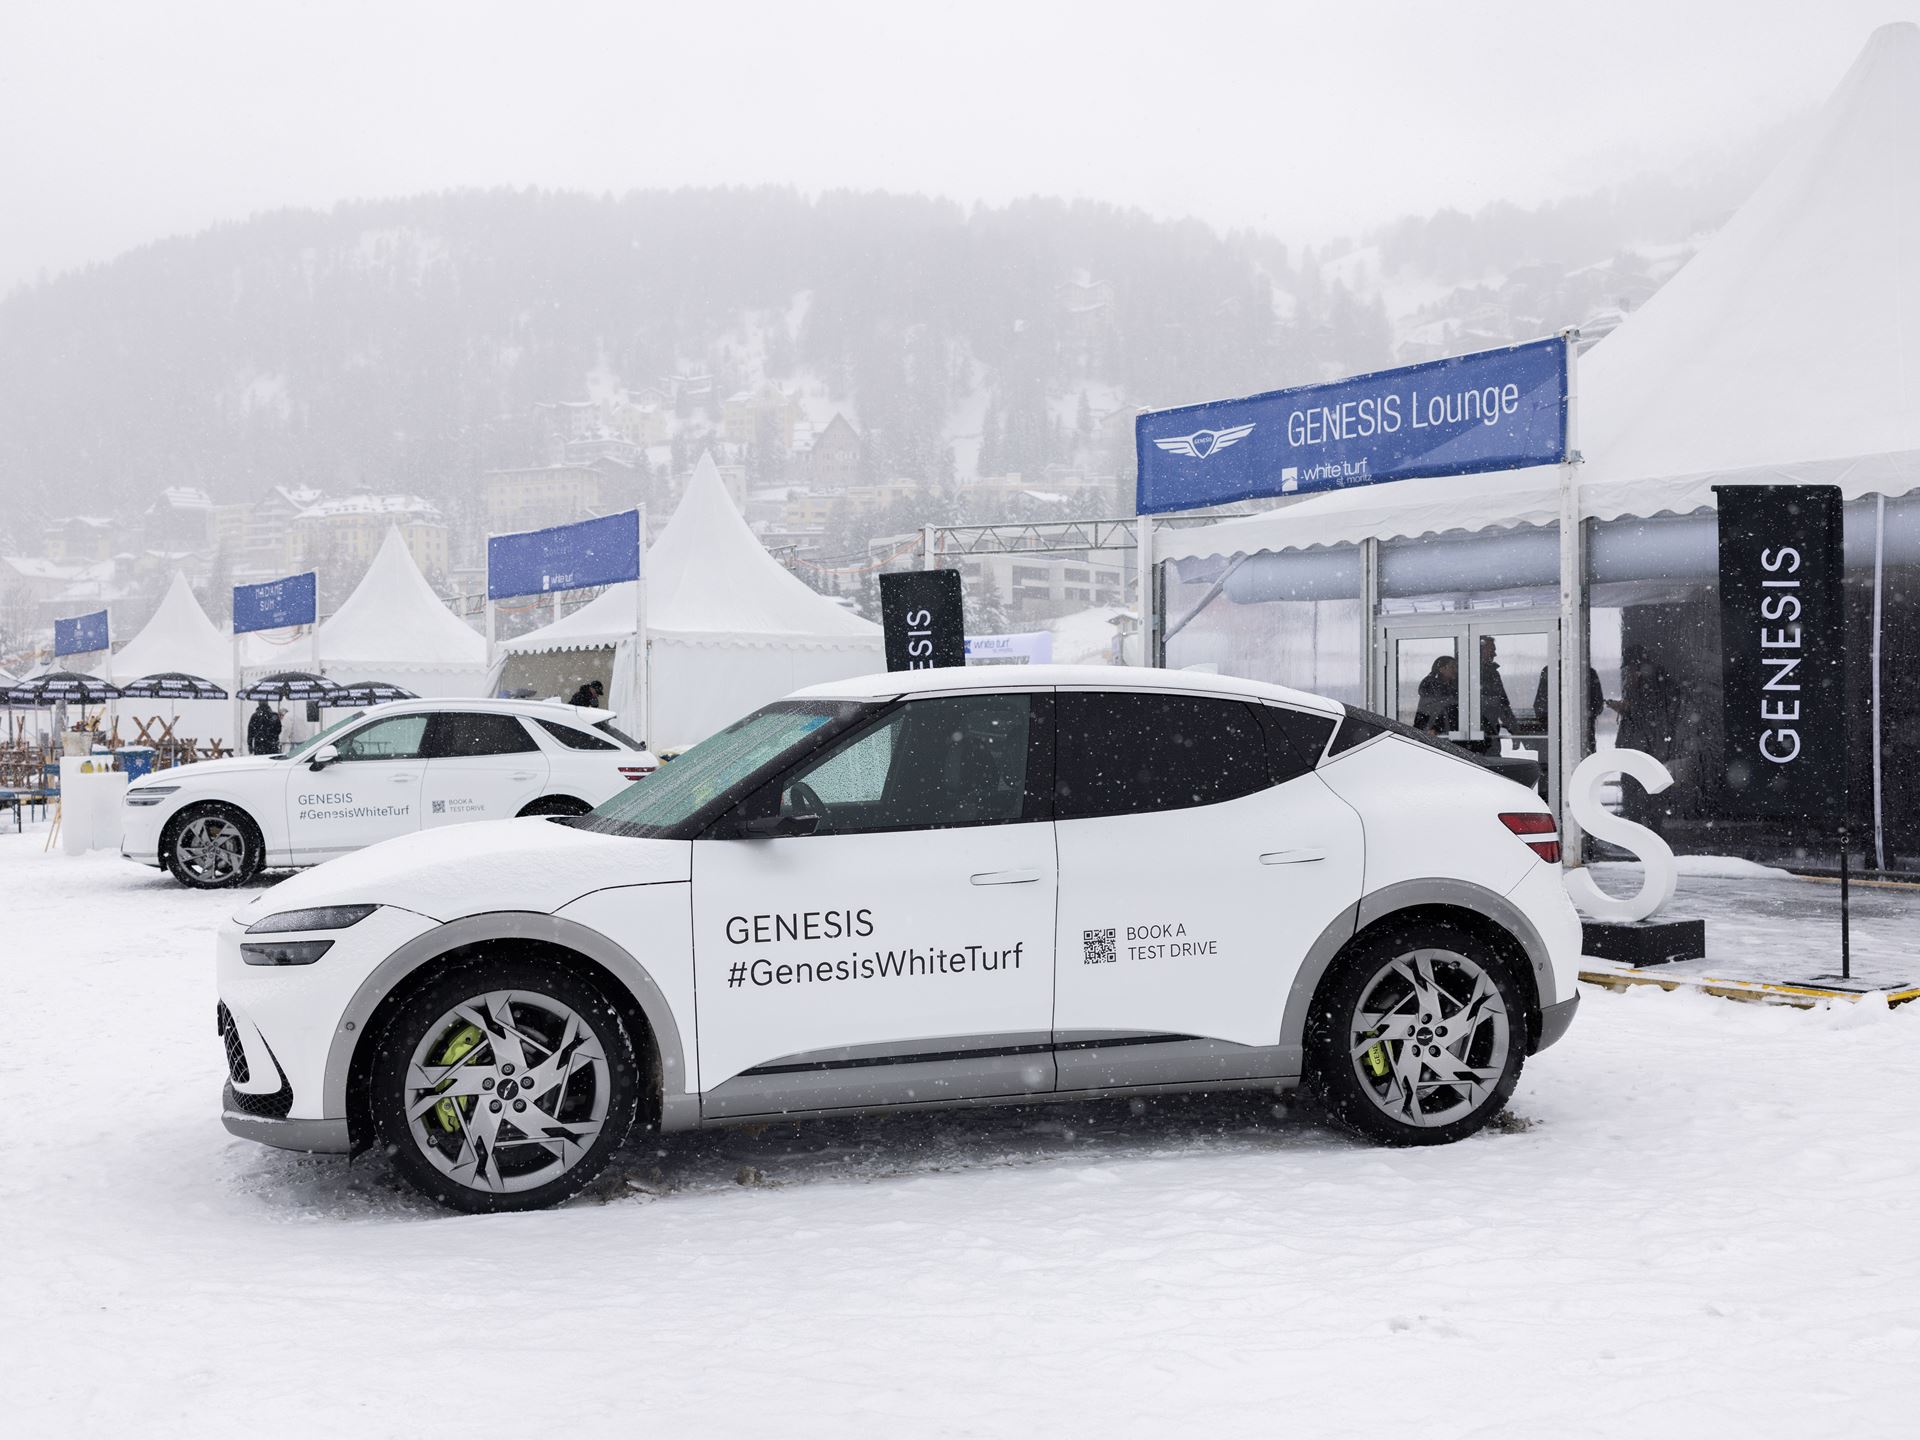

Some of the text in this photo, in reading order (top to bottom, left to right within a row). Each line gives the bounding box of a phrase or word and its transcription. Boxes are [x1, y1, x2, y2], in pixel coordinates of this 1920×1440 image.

[1288, 383, 1519, 447] GENESIS Lounge
[1303, 457, 1367, 481] white turf
[1759, 547, 1801, 764] GENESIS
[298, 793, 353, 806] GENESIS
[300, 805, 409, 820] #GenesisWhiteTurf
[726, 909, 874, 944] GENESIS
[1127, 923, 1187, 940] BOOK A
[1128, 940, 1218, 960] TEST DRIVE
[728, 942, 1023, 988] #GenesisWhiteTurf
